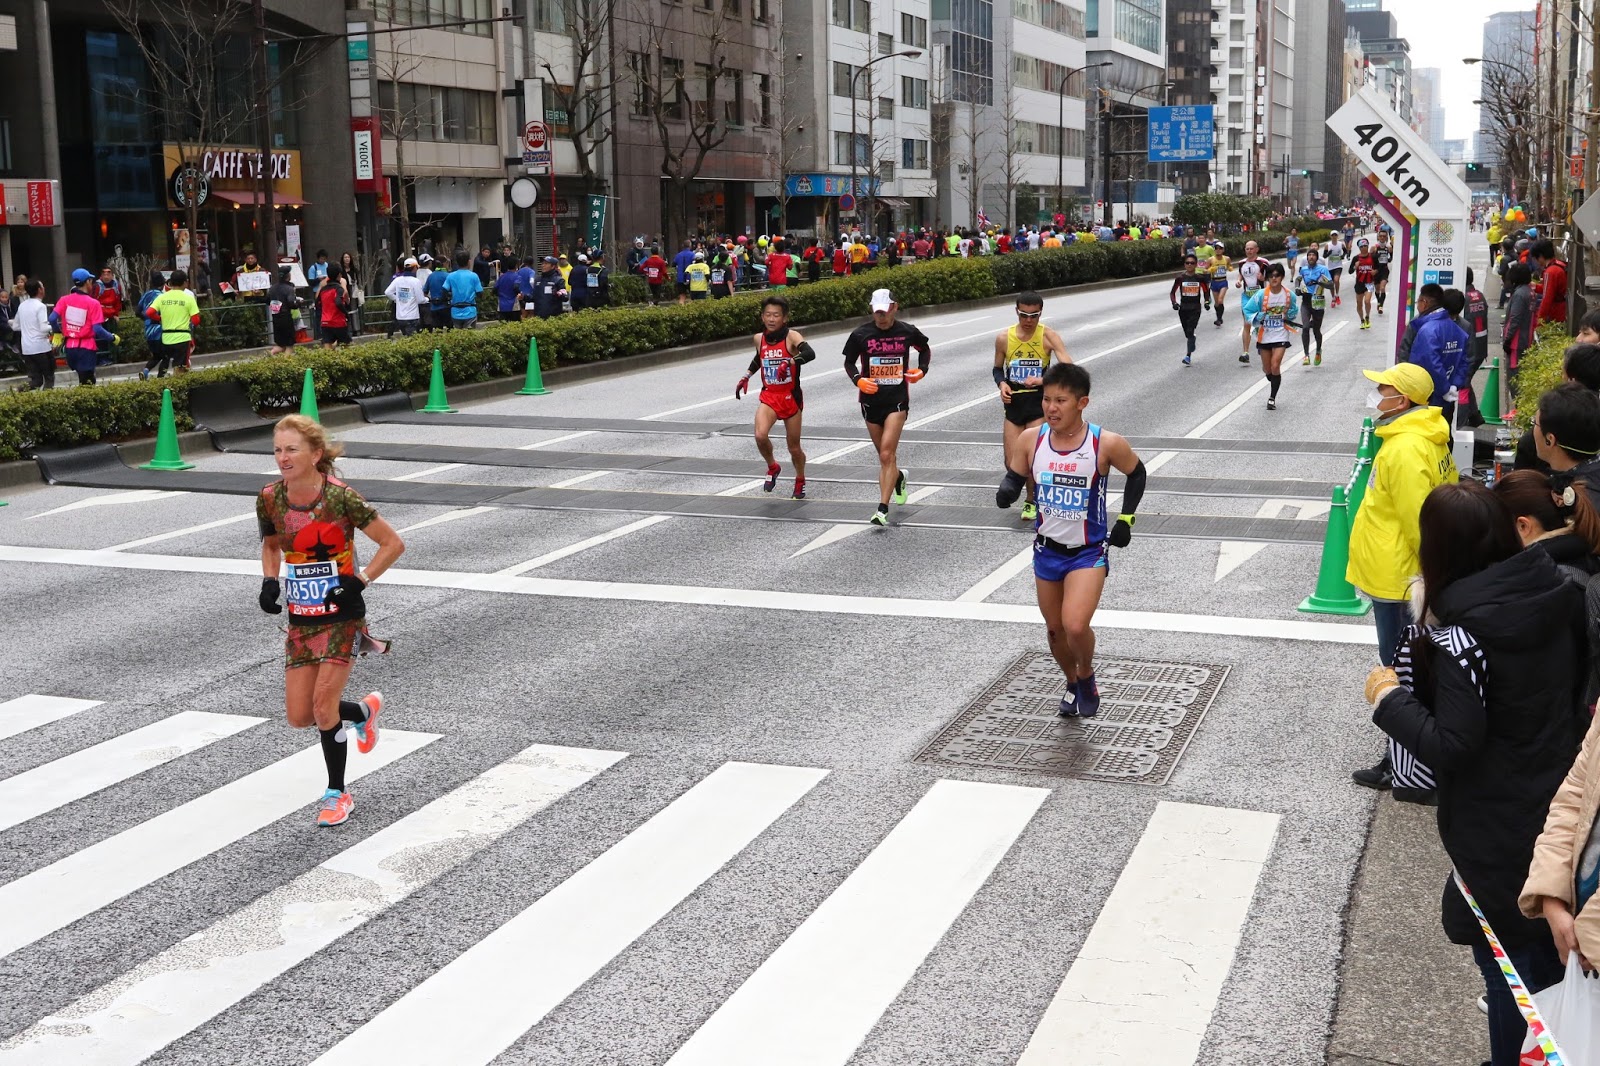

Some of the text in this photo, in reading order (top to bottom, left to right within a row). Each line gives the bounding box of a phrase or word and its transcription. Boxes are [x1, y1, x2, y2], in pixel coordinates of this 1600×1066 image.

[1171, 107, 1196, 115] 芝公園
[359, 141, 369, 168] VELOCE
[203, 151, 292, 179] CAFFE VEOCE
[1354, 123, 1430, 207] 40km
[30, 183, 41, 225] ゴルフジャパン
[1427, 258, 1452, 267] 2018
[870, 365, 899, 376] B26202
[1010, 367, 1038, 378] A4173
[1054, 476, 1085, 485] 東京メトロ
[1037, 485, 1082, 507] A4509
[296, 567, 330, 576] 東京メトロ
